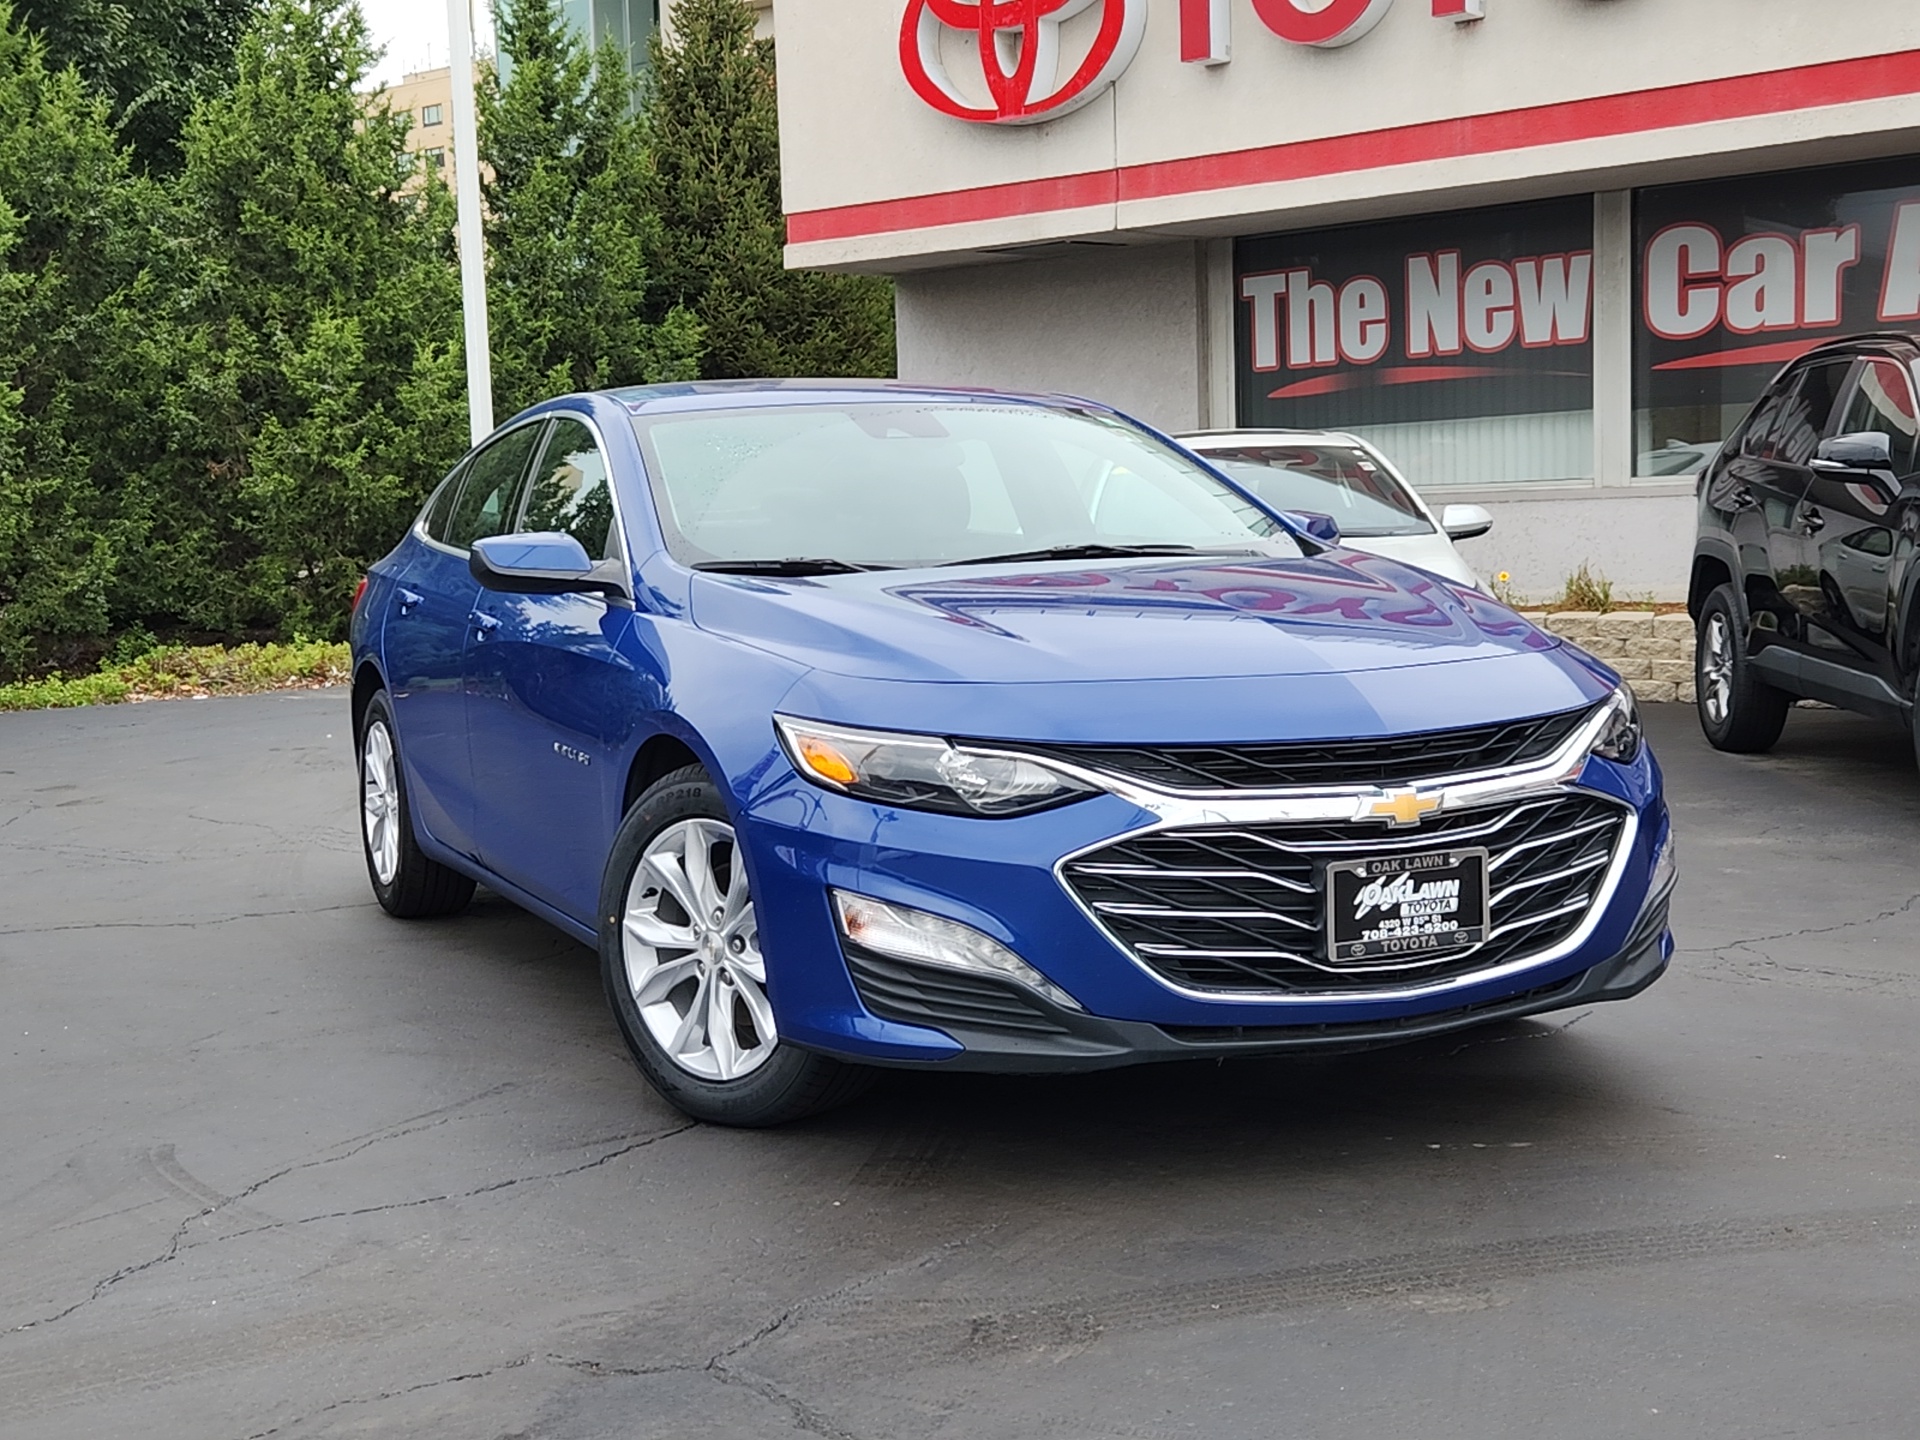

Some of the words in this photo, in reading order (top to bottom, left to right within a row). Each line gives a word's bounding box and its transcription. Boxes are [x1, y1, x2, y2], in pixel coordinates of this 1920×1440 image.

[1241, 268, 1388, 371] The
[1405, 250, 1592, 358] New
[1644, 223, 1859, 338] Car
[1372, 860, 1401, 873] OAK
[1404, 855, 1444, 870] LAWN
[1407, 899, 1451, 914] TOYOTA
[1402, 917, 1411, 926] W
[1361, 920, 1459, 941] 708-423-5200
[1381, 935, 1438, 952] TOYOTA
